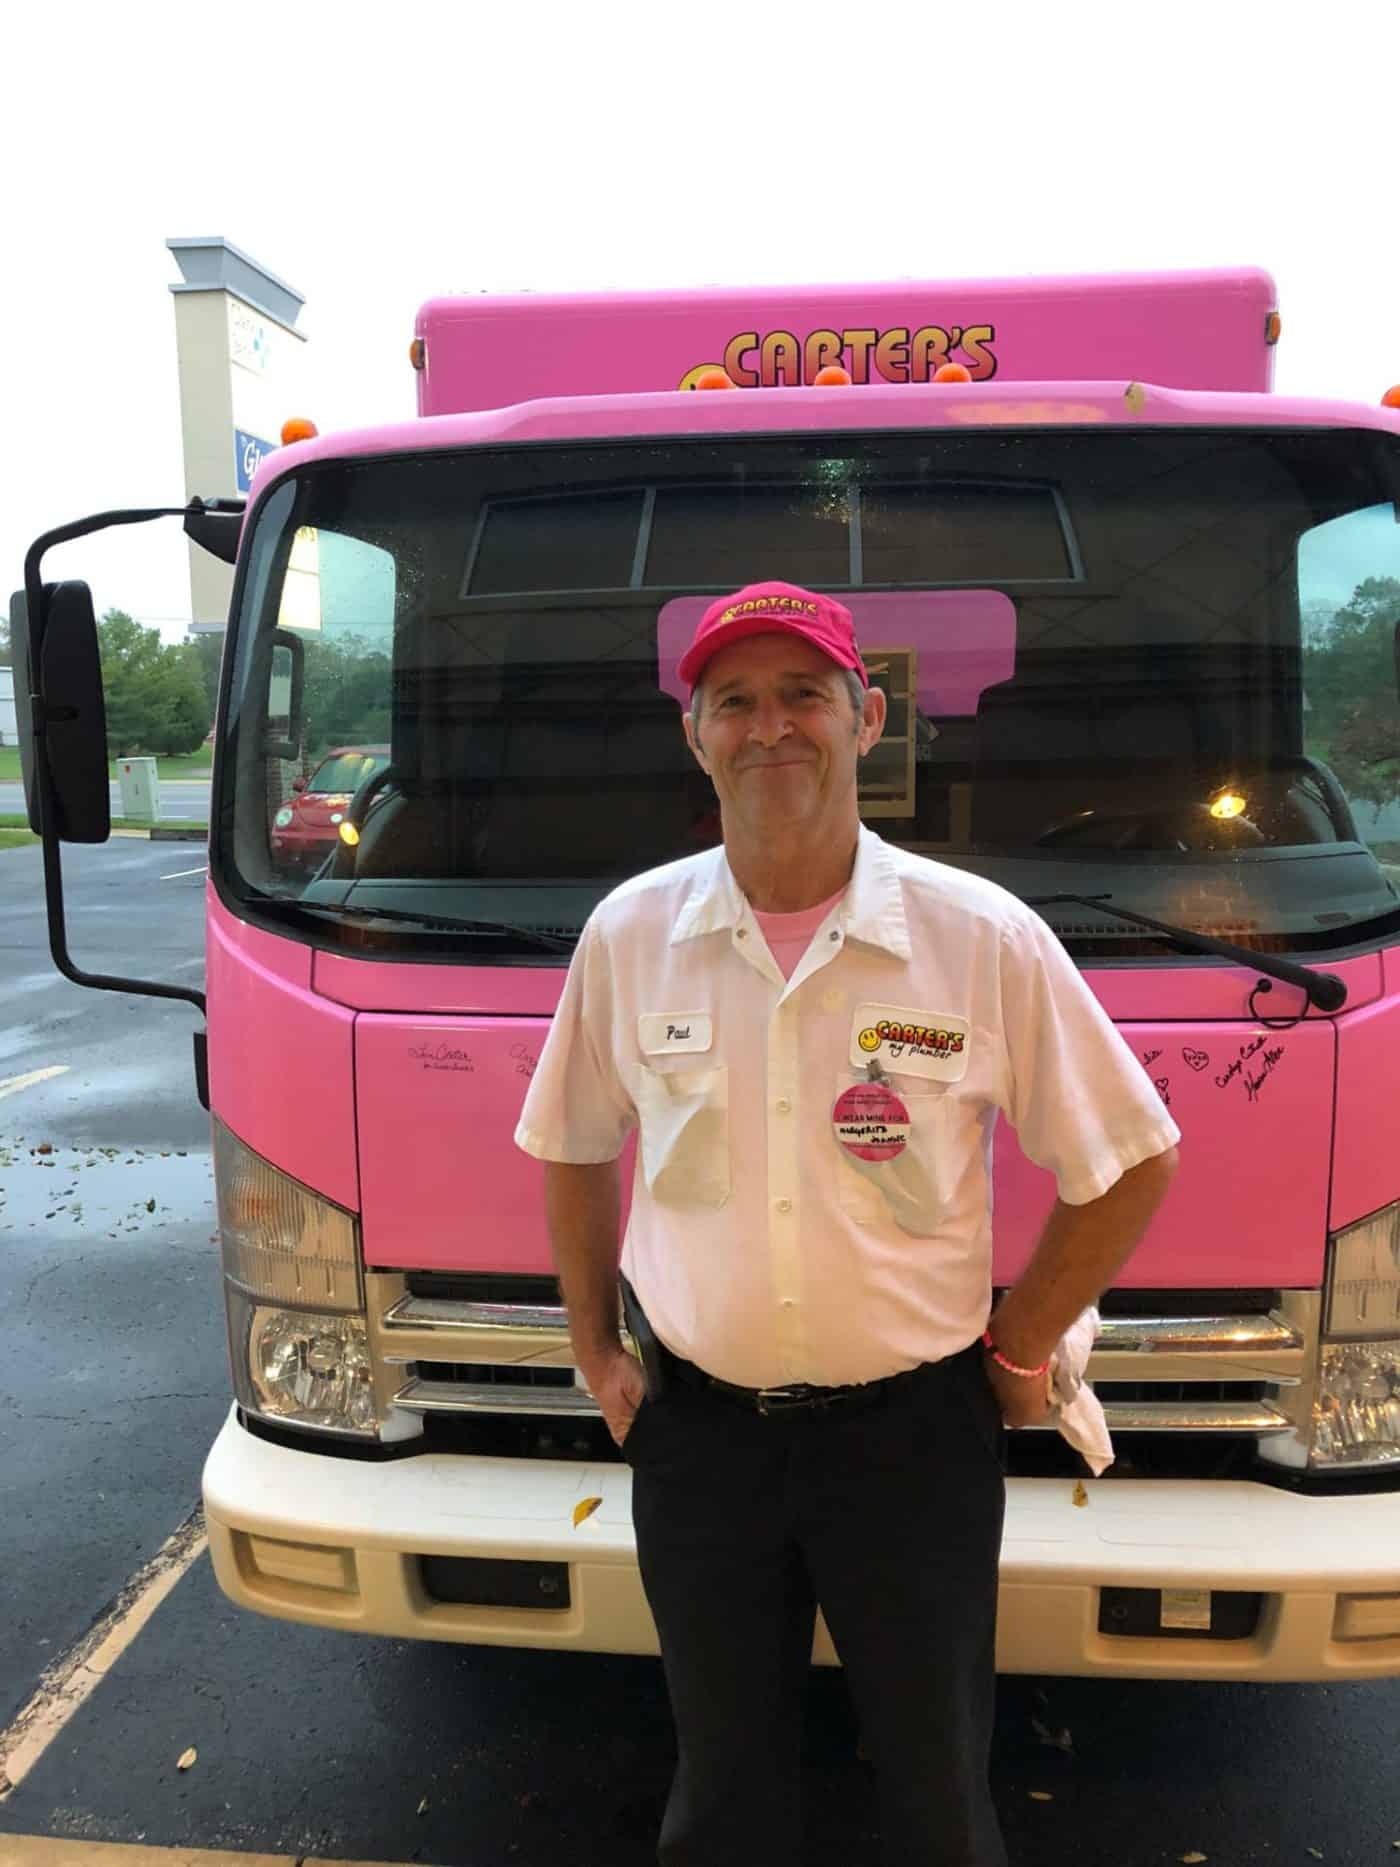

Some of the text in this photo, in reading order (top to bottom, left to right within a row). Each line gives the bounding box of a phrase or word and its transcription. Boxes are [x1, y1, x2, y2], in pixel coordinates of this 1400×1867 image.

[723, 325, 997, 387] CARTER'S
[666, 1024, 692, 1041] Paul
[876, 1020, 965, 1052] CARTER'S
[888, 1042, 952, 1059] my plumber
